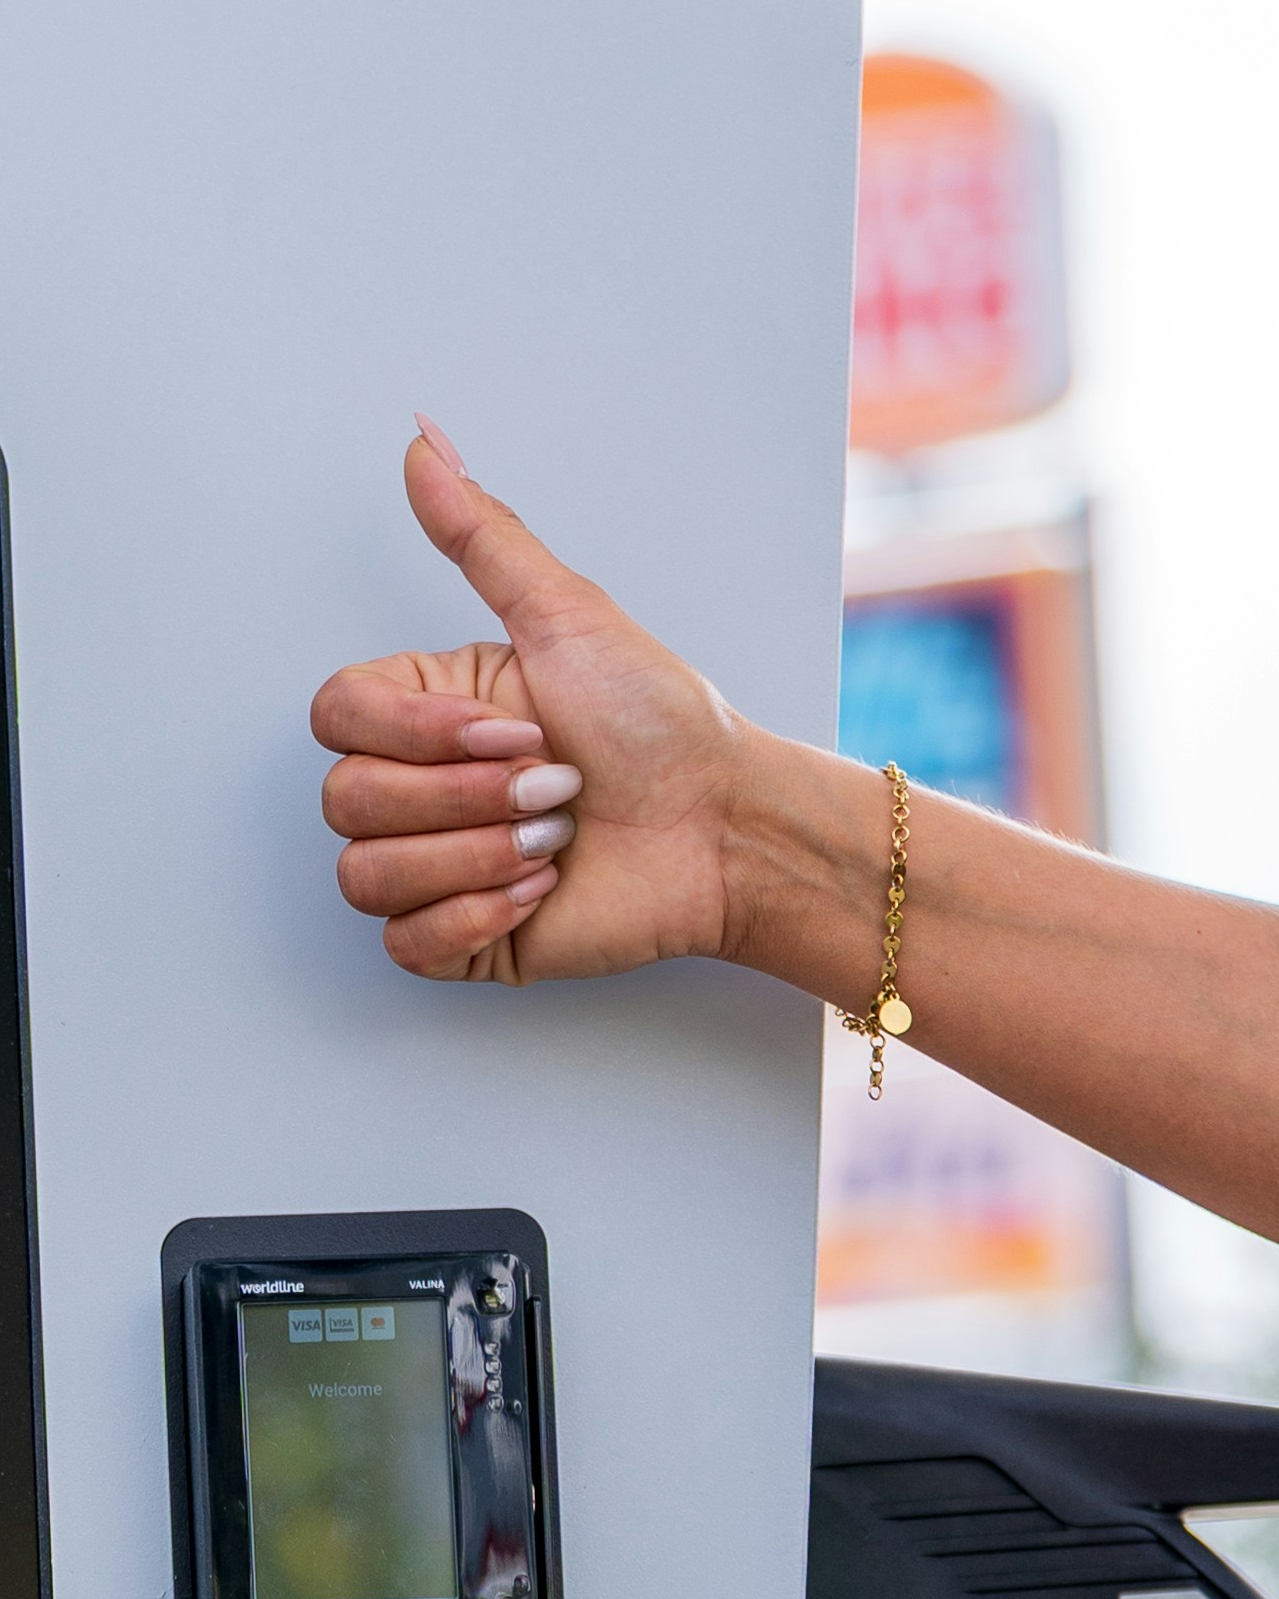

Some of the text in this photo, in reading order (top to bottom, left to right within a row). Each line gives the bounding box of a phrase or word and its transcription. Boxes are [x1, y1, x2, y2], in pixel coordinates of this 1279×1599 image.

[240, 1279, 306, 1295] worldline
[408, 1278, 446, 1291] VALINA
[291, 1319, 322, 1333] VISA
[308, 1382, 383, 1399] Welcome
